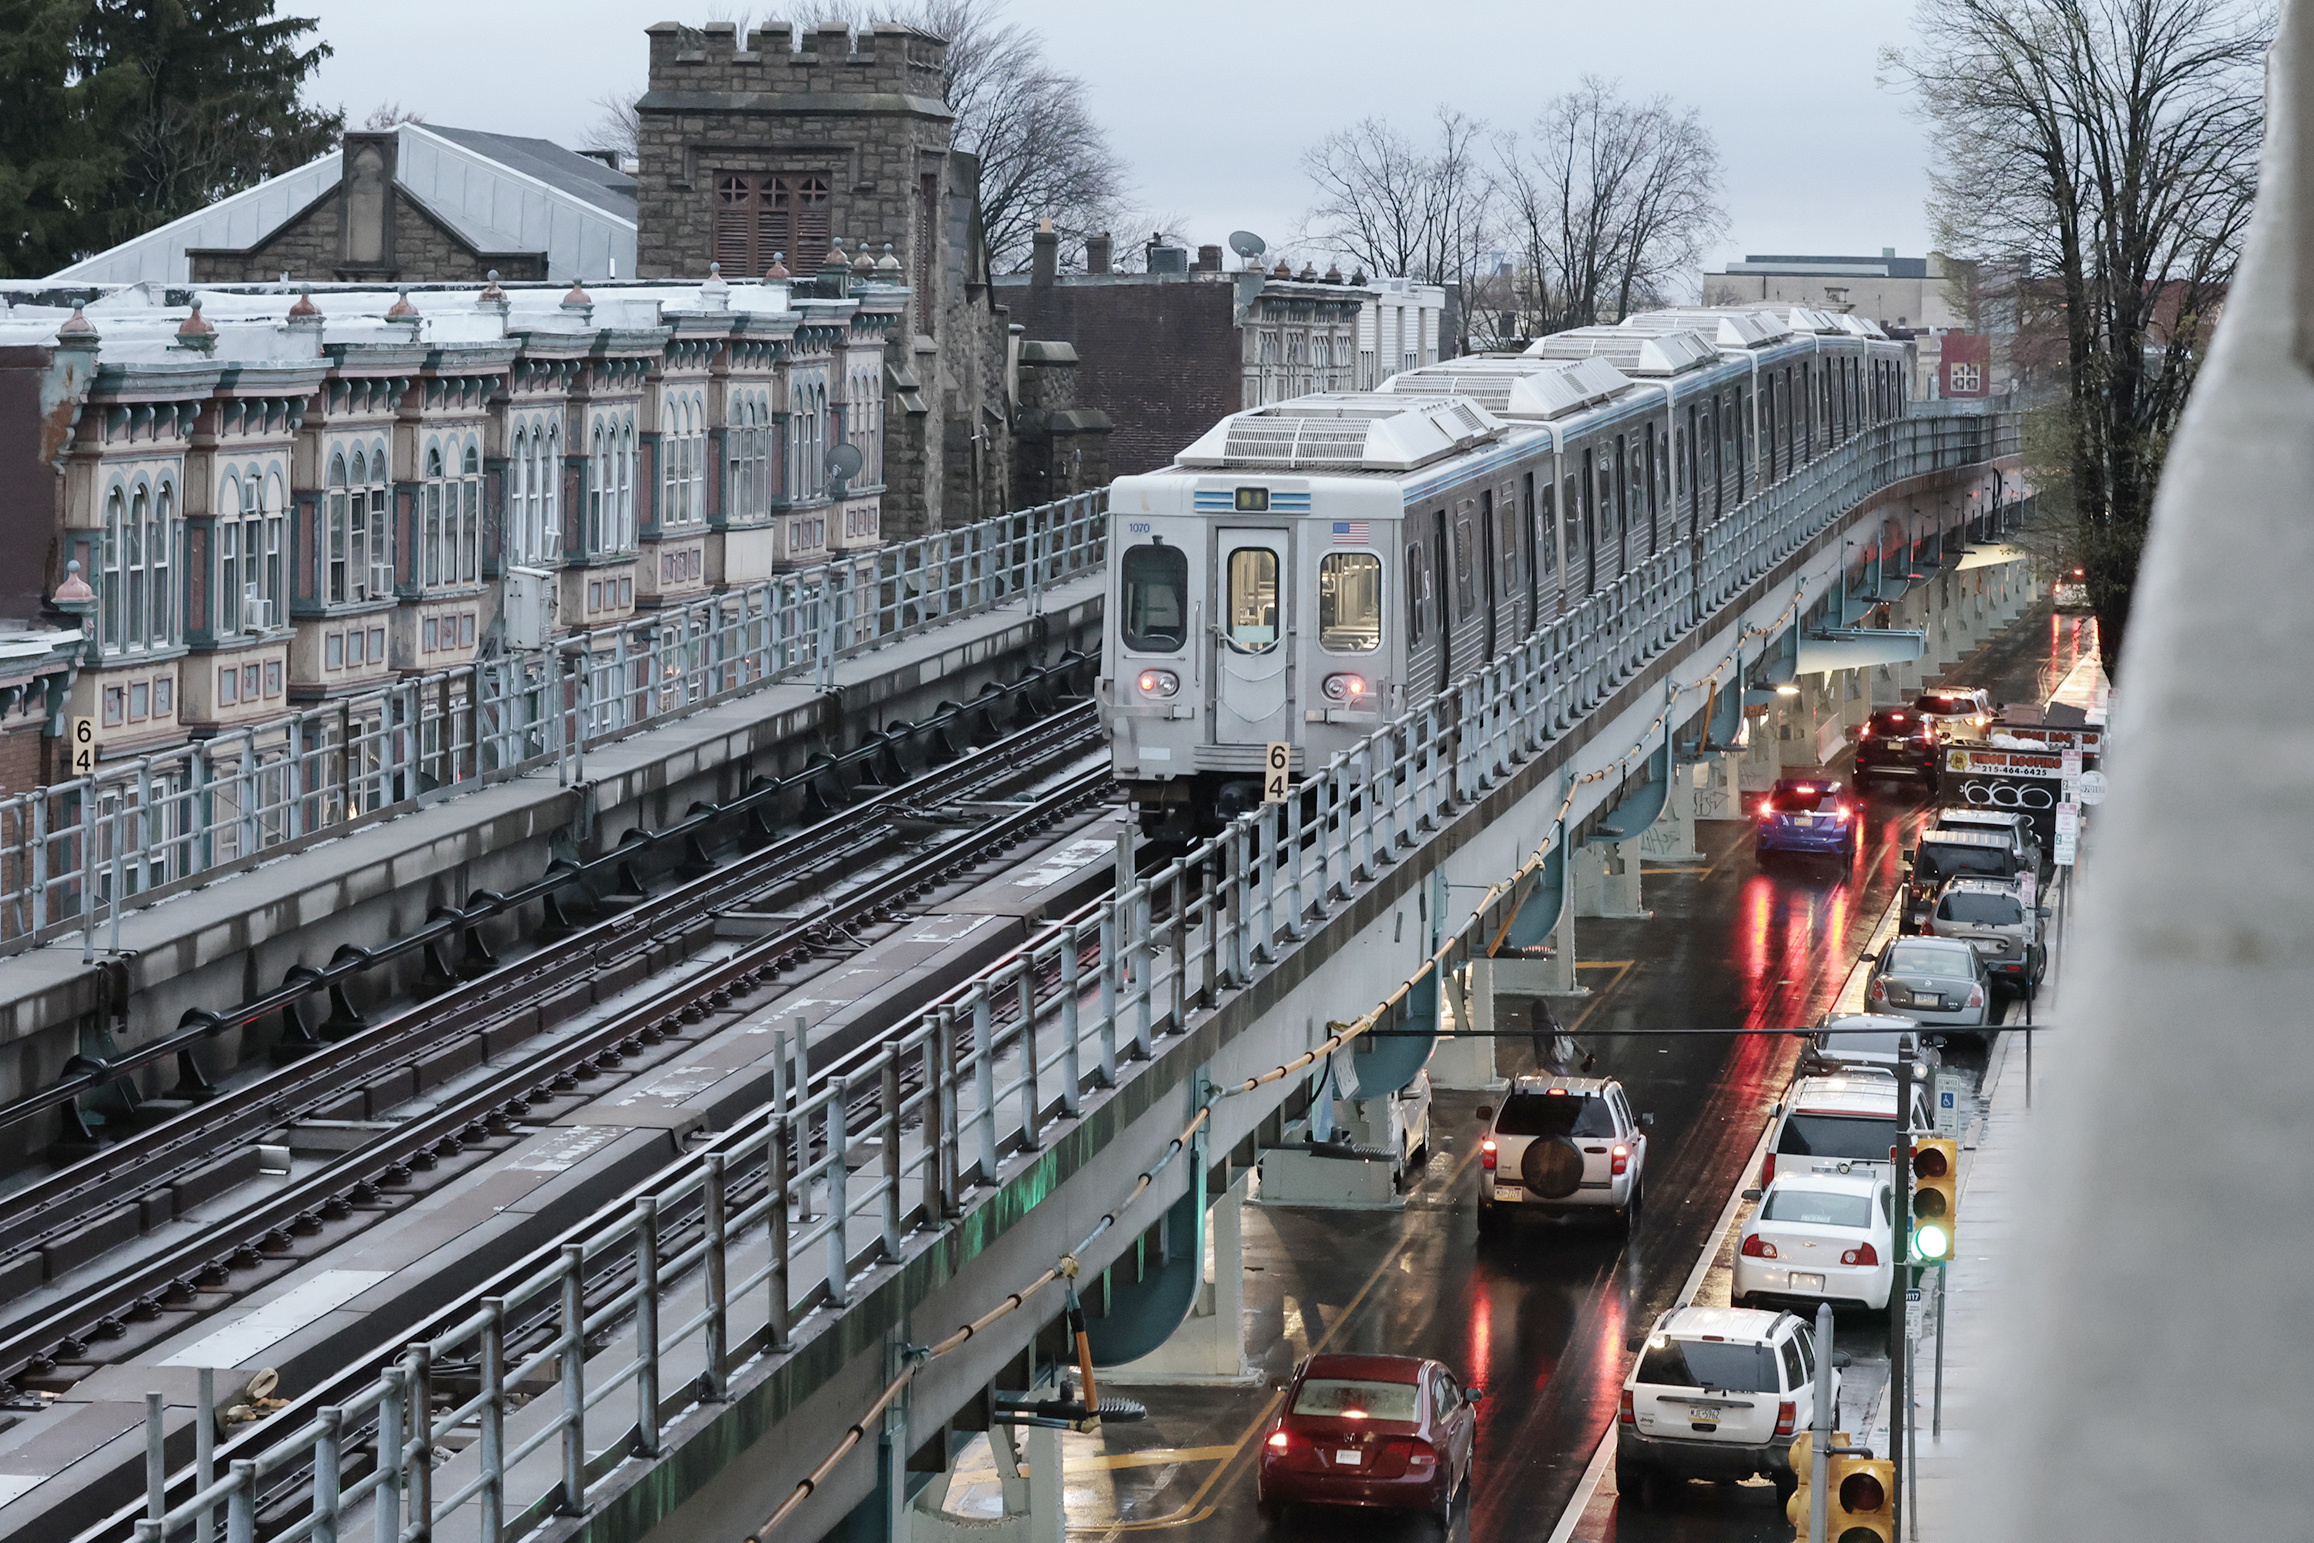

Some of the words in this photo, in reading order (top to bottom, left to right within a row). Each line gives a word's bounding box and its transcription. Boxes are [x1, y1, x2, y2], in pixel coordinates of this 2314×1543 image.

[1129, 523, 1150, 533] 1070
[77, 719, 92, 743] 6
[2049, 731, 2099, 745] ROONG
[76, 749, 91, 771] 4
[1271, 745, 1286, 770] 6
[1969, 752, 2007, 766] UNION
[2009, 754, 2063, 769] ROOFING
[1982, 765, 2047, 776] 215-464-6425
[1269, 775, 1284, 799] 4
[2056, 835, 2061, 844] 2
